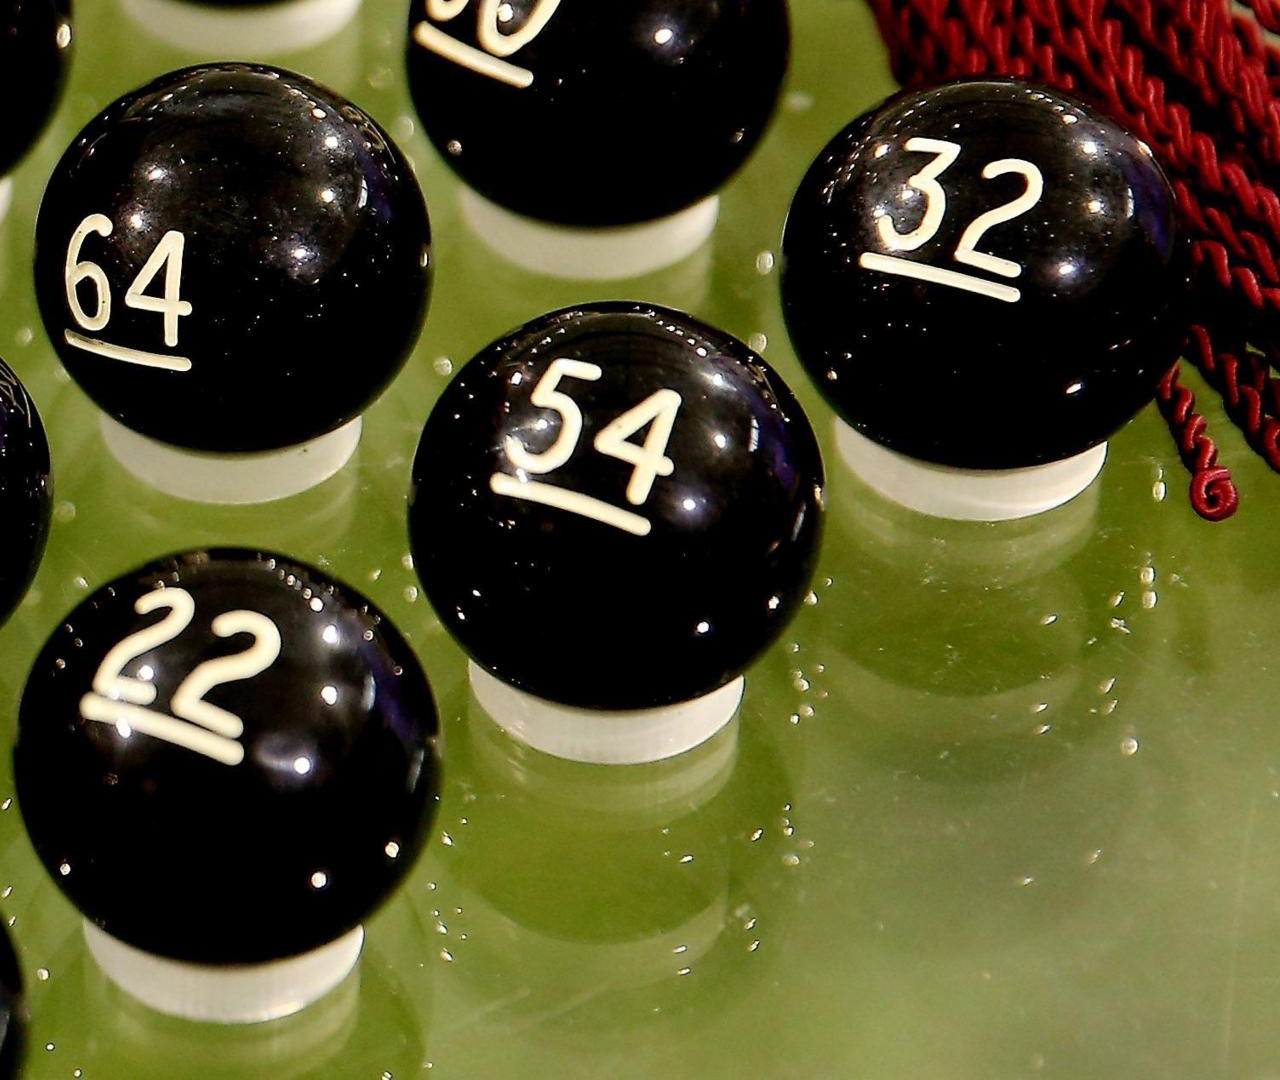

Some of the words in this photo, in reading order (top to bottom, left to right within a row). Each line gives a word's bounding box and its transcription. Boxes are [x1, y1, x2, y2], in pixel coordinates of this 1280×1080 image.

[64, 213, 194, 347] 64
[876, 137, 1044, 278] 32
[504, 357, 682, 506] 54
[90, 585, 282, 739] 22
